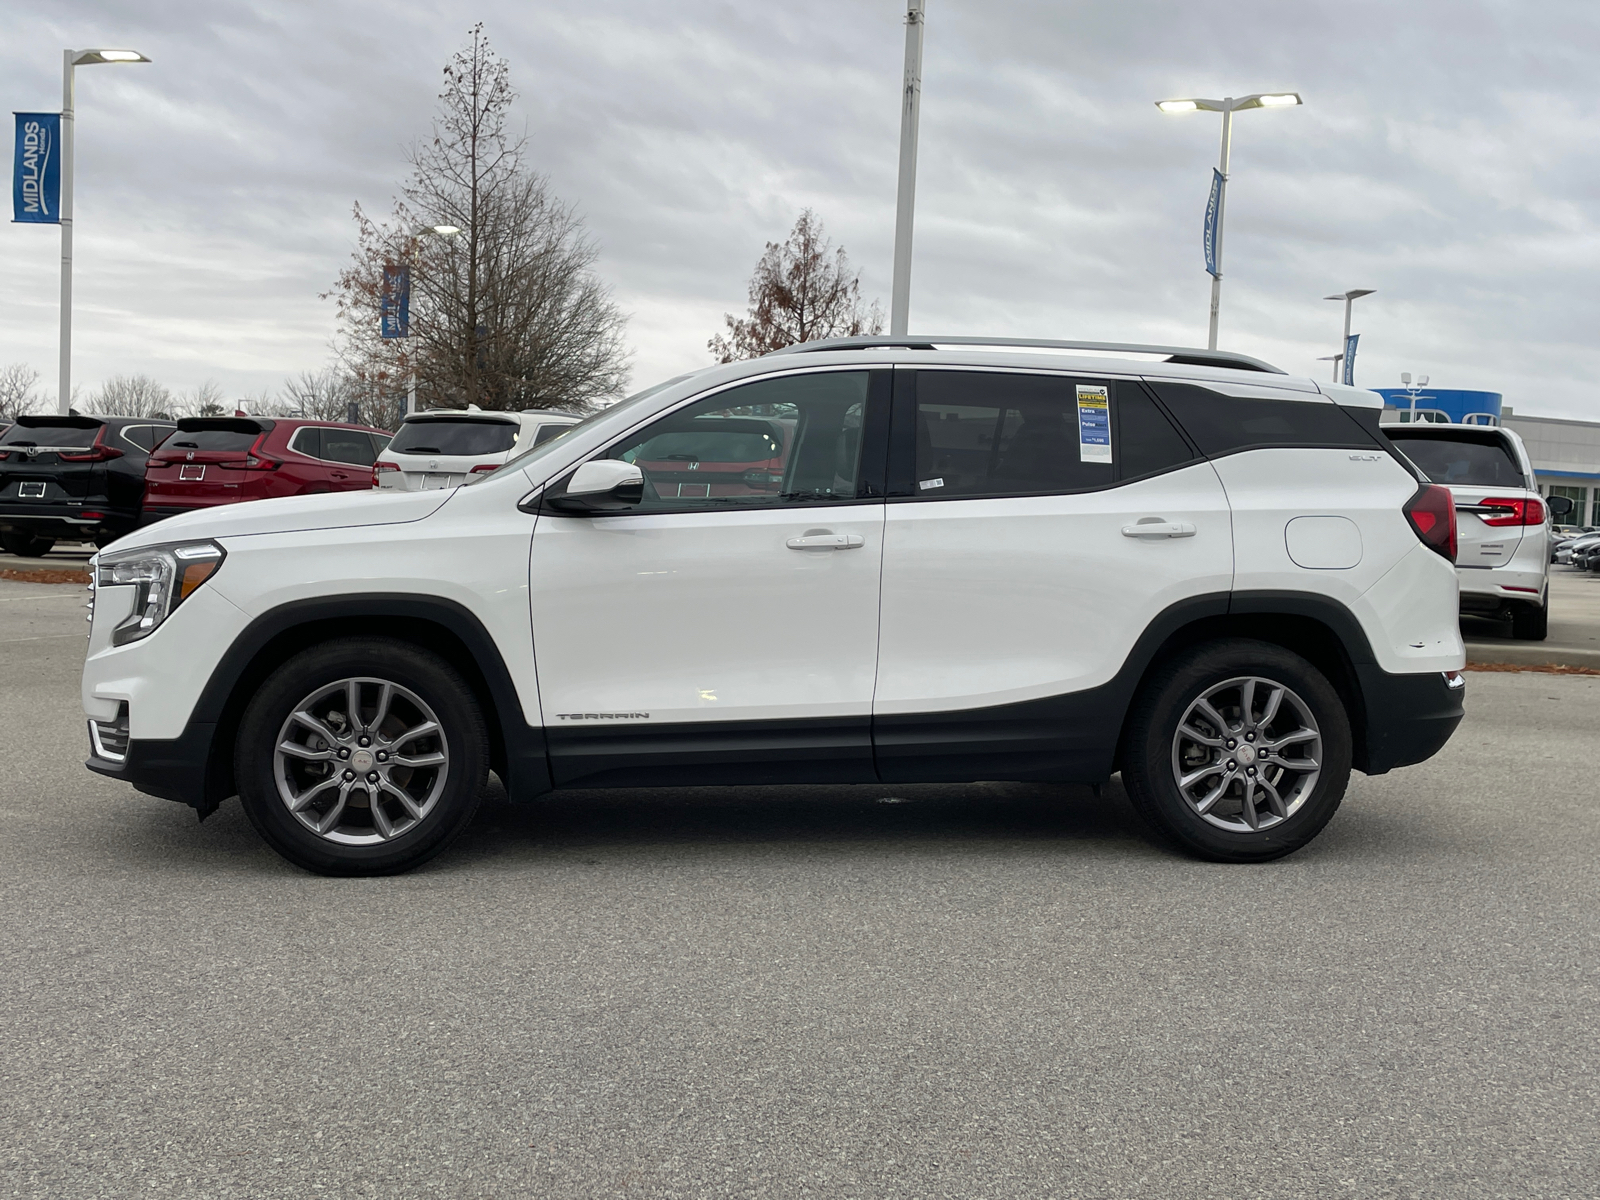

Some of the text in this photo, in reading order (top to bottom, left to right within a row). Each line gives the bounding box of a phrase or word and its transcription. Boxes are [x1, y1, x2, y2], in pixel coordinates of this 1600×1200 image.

[23, 121, 39, 213] MIDLANDS
[1206, 179, 1218, 264] MIDLANDS
[387, 272, 397, 331] MIDLAN
[556, 712, 650, 721] TERRAIN
